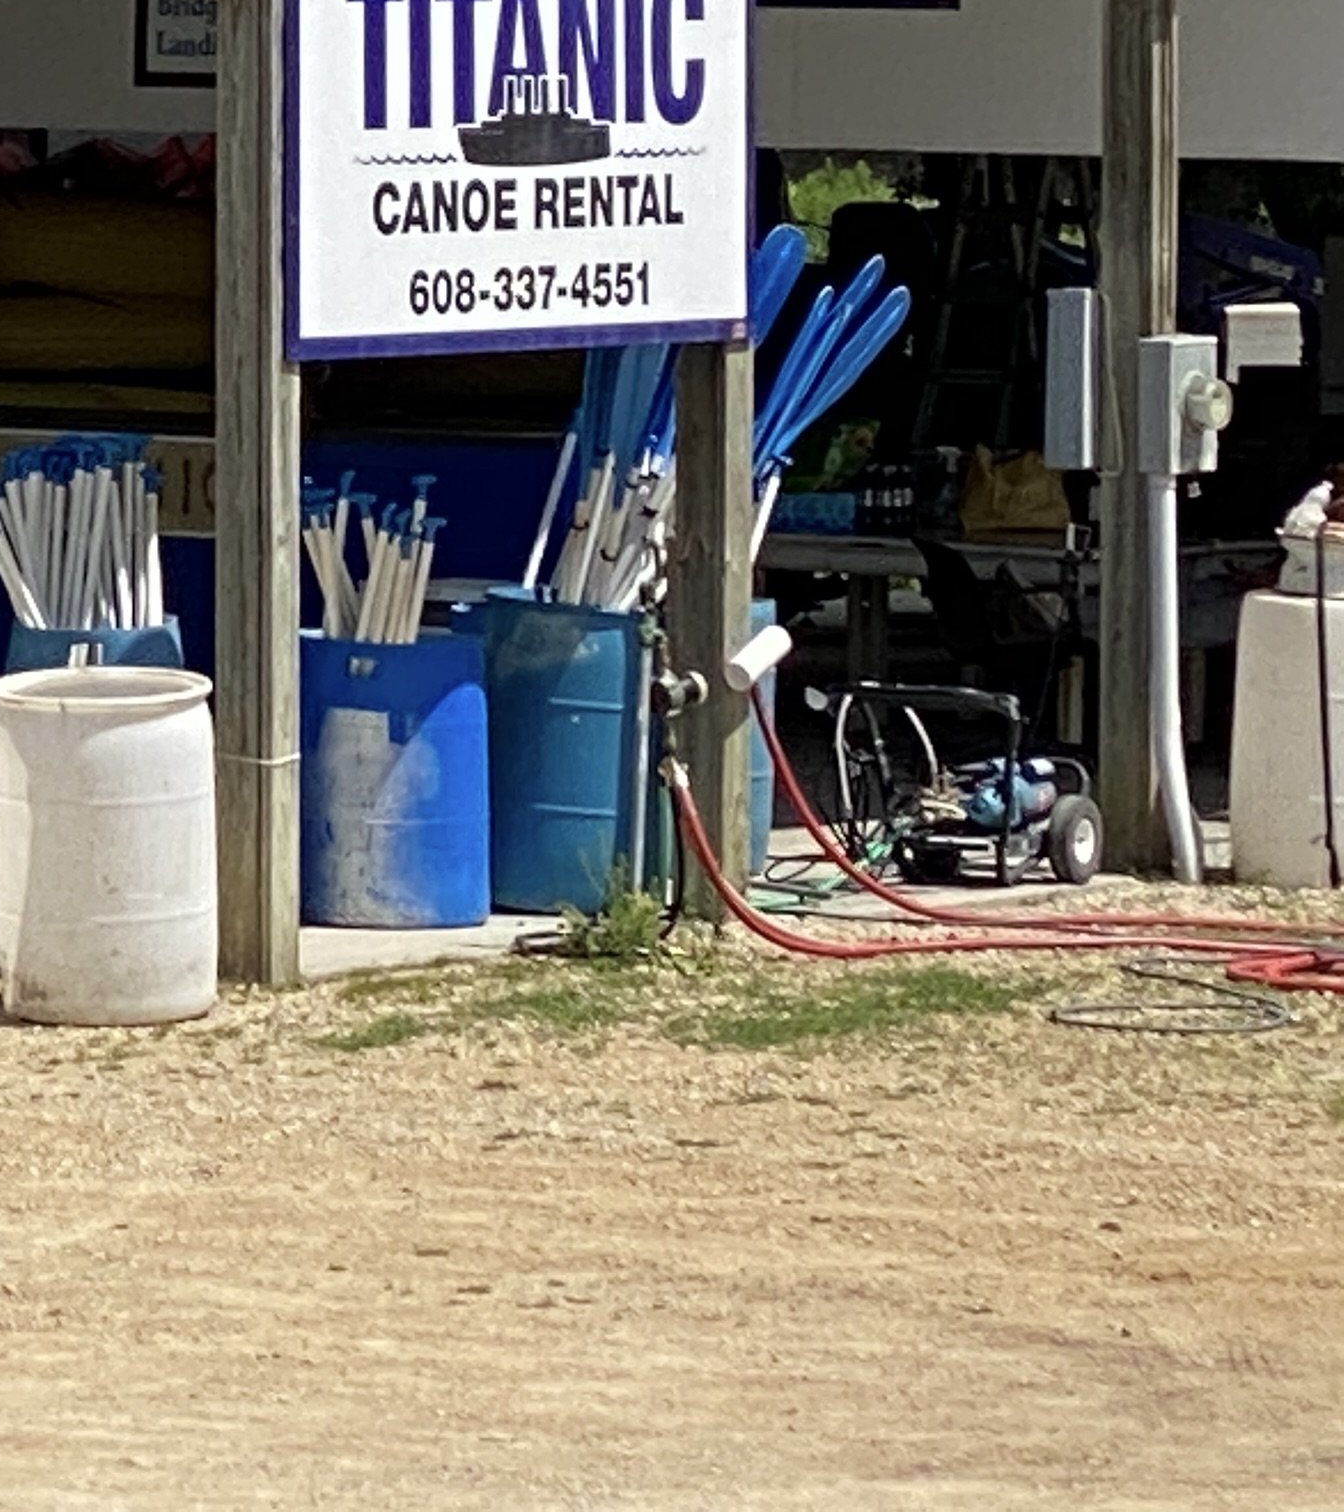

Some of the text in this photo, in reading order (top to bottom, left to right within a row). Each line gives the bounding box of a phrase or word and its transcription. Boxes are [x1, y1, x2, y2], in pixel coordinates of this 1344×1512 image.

[372, 173, 684, 236] CANOE RENTAL
[409, 261, 649, 316] 608-337-4551
